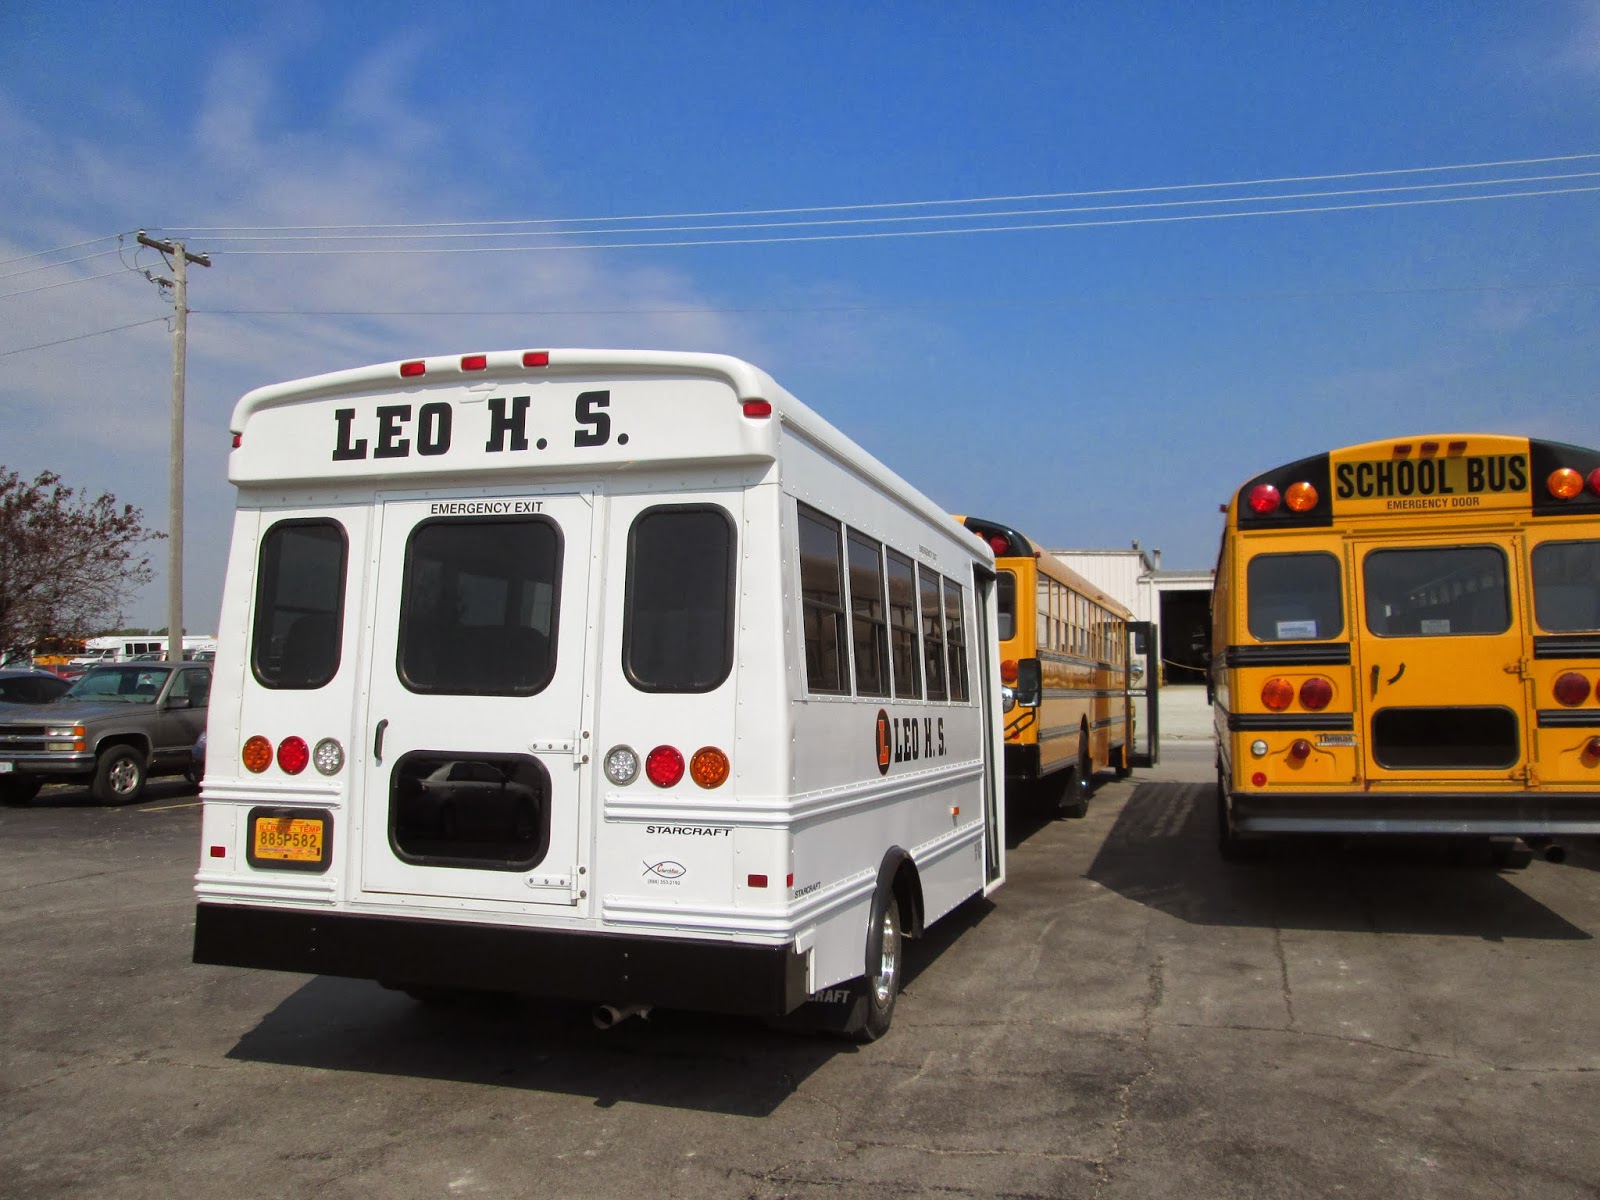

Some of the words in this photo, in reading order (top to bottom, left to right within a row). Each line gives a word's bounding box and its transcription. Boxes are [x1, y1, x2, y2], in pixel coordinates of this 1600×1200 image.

[331, 401, 453, 461] LEO
[485, 396, 548, 453] H.
[574, 390, 629, 447] S.
[1337, 459, 1454, 498] SCHOOL
[1467, 455, 1527, 492] BUS
[430, 503, 511, 514] EMERGENCY
[514, 501, 543, 513] EXIT
[1387, 498, 1448, 510] EMERGENCY
[1452, 497, 1480, 507] DOOR
[879, 719, 889, 765] L
[894, 717, 920, 763] LEO
[924, 717, 936, 758] H.
[938, 717, 947, 756] S.
[300, 825, 321, 833] TEMP
[646, 825, 733, 837] STARCRAFT
[260, 831, 317, 848] 885P582
[794, 882, 821, 899] STARCRAFT
